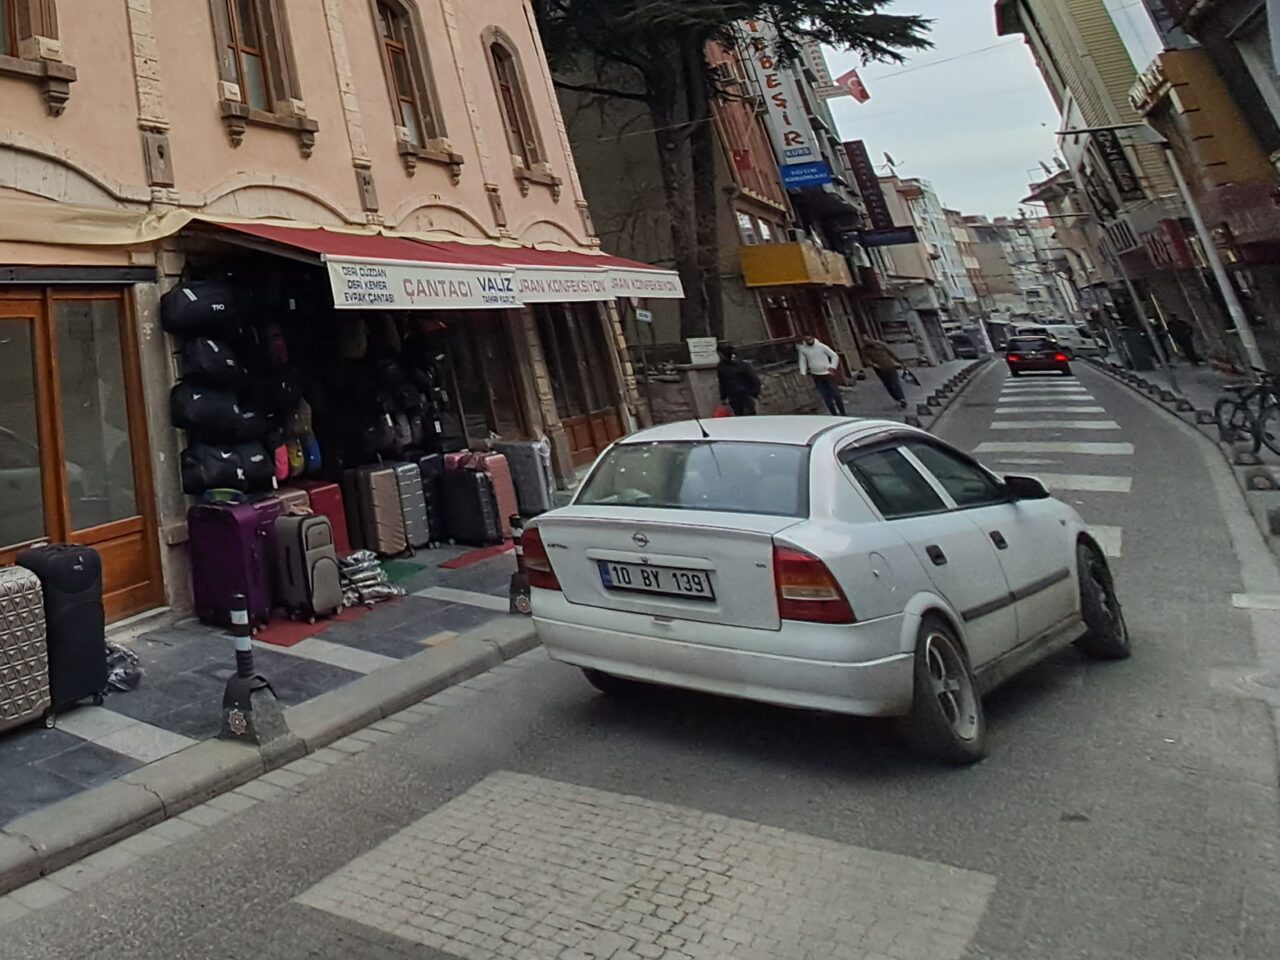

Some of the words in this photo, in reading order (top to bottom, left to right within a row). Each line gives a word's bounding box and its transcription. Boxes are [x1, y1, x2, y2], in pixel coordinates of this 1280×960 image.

[365, 280, 388, 290] KEMER
[402, 278, 473, 304] ÇANTACI
[344, 292, 367, 302] EVRAK
[612, 565, 631, 585] 10
[641, 569, 660, 589] BY
[672, 572, 705, 593] 139
